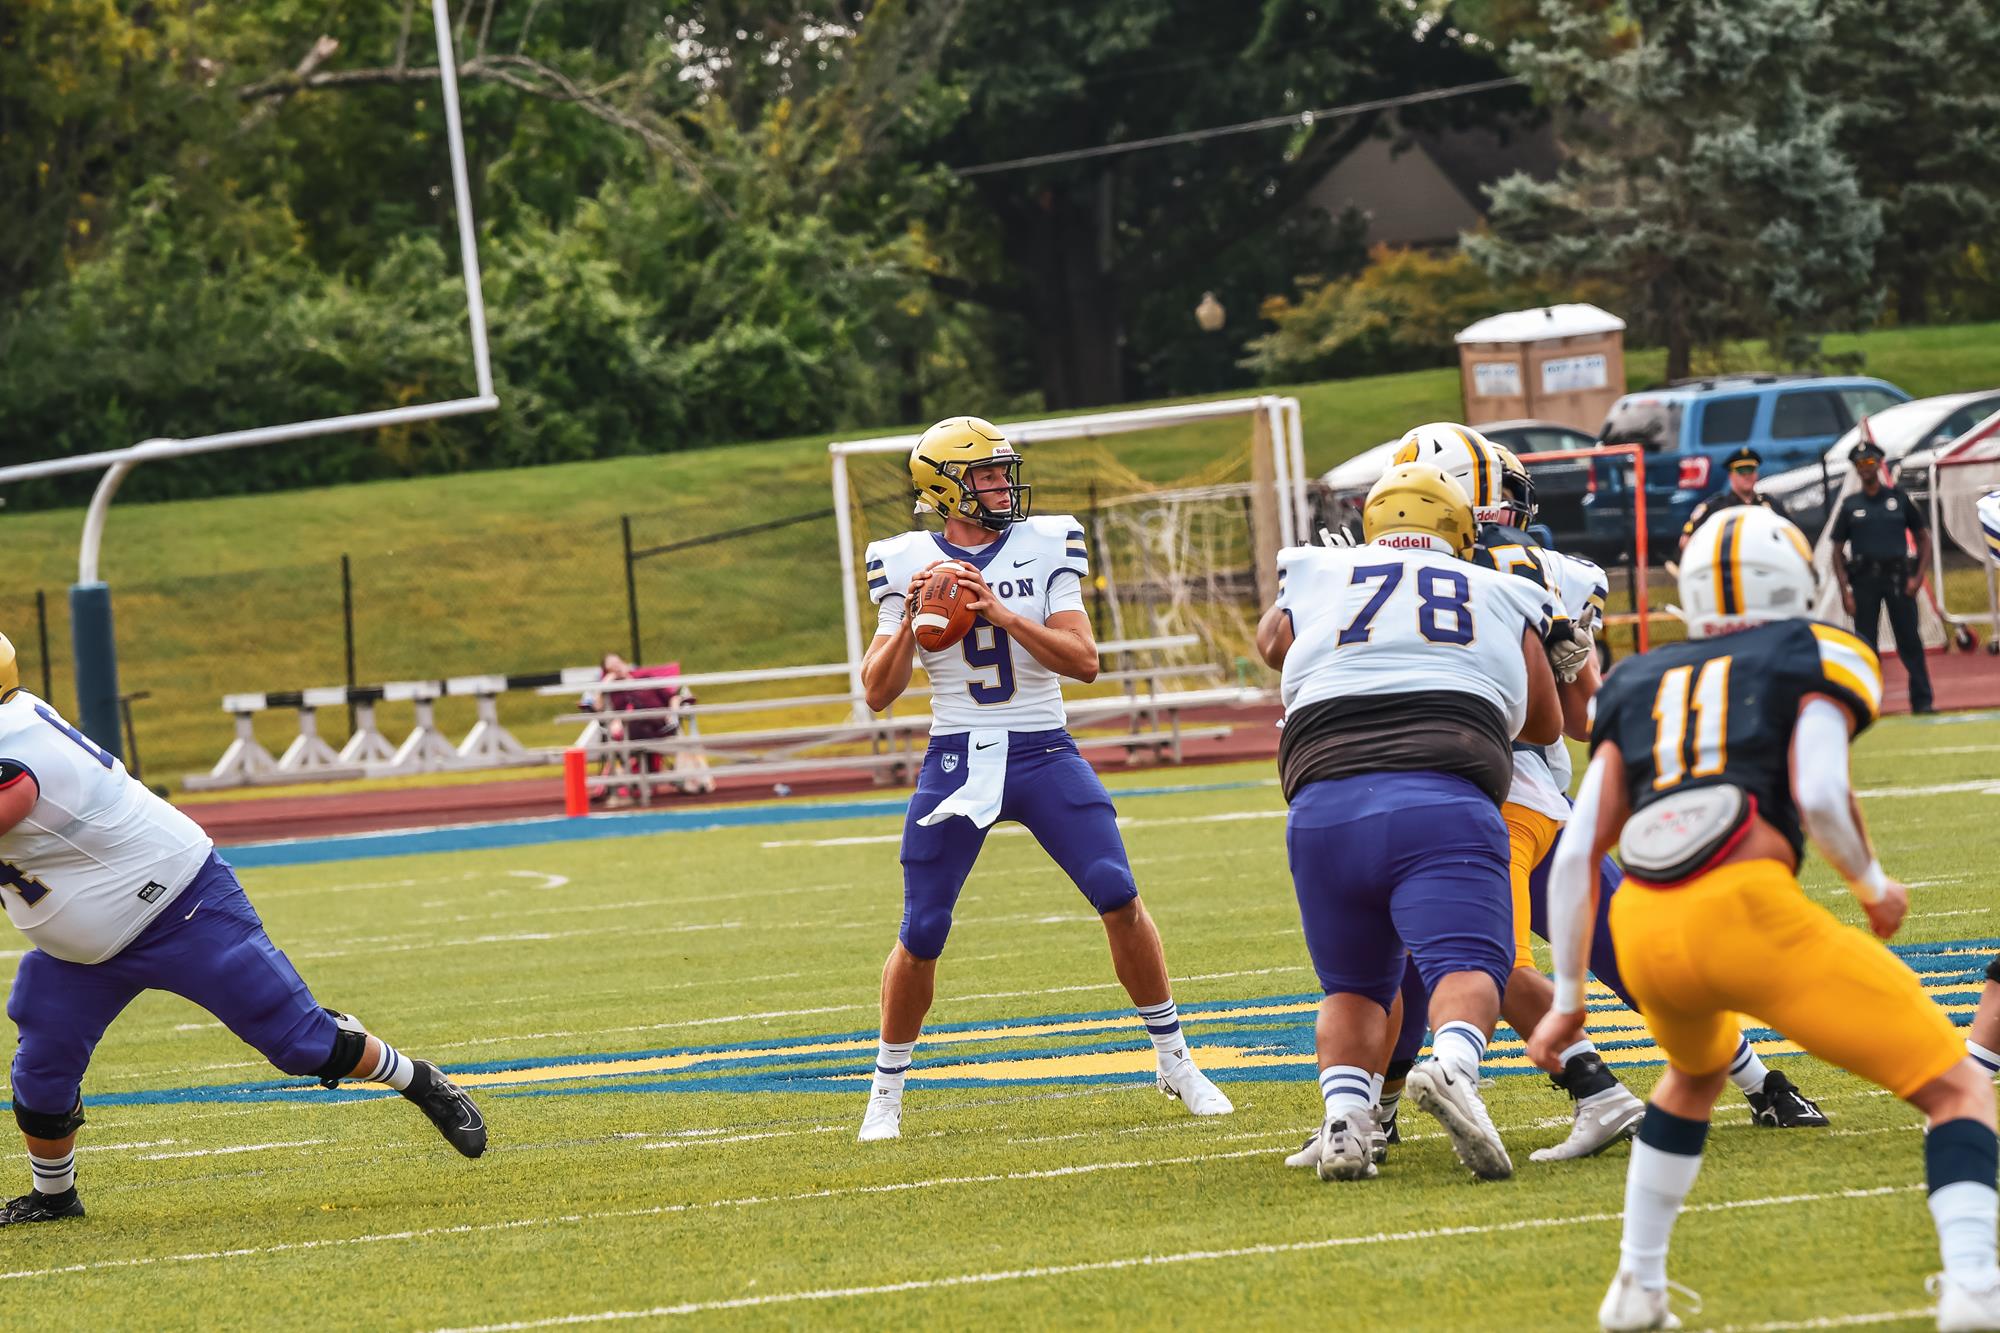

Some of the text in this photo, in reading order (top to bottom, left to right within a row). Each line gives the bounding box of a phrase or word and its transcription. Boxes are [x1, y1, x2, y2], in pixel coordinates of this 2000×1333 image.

[1476, 510, 1499, 521] ddell
[986, 578, 1034, 598] ON
[1336, 561, 1476, 648] 78
[961, 612, 1018, 705] 9
[1651, 655, 1733, 791] 11
